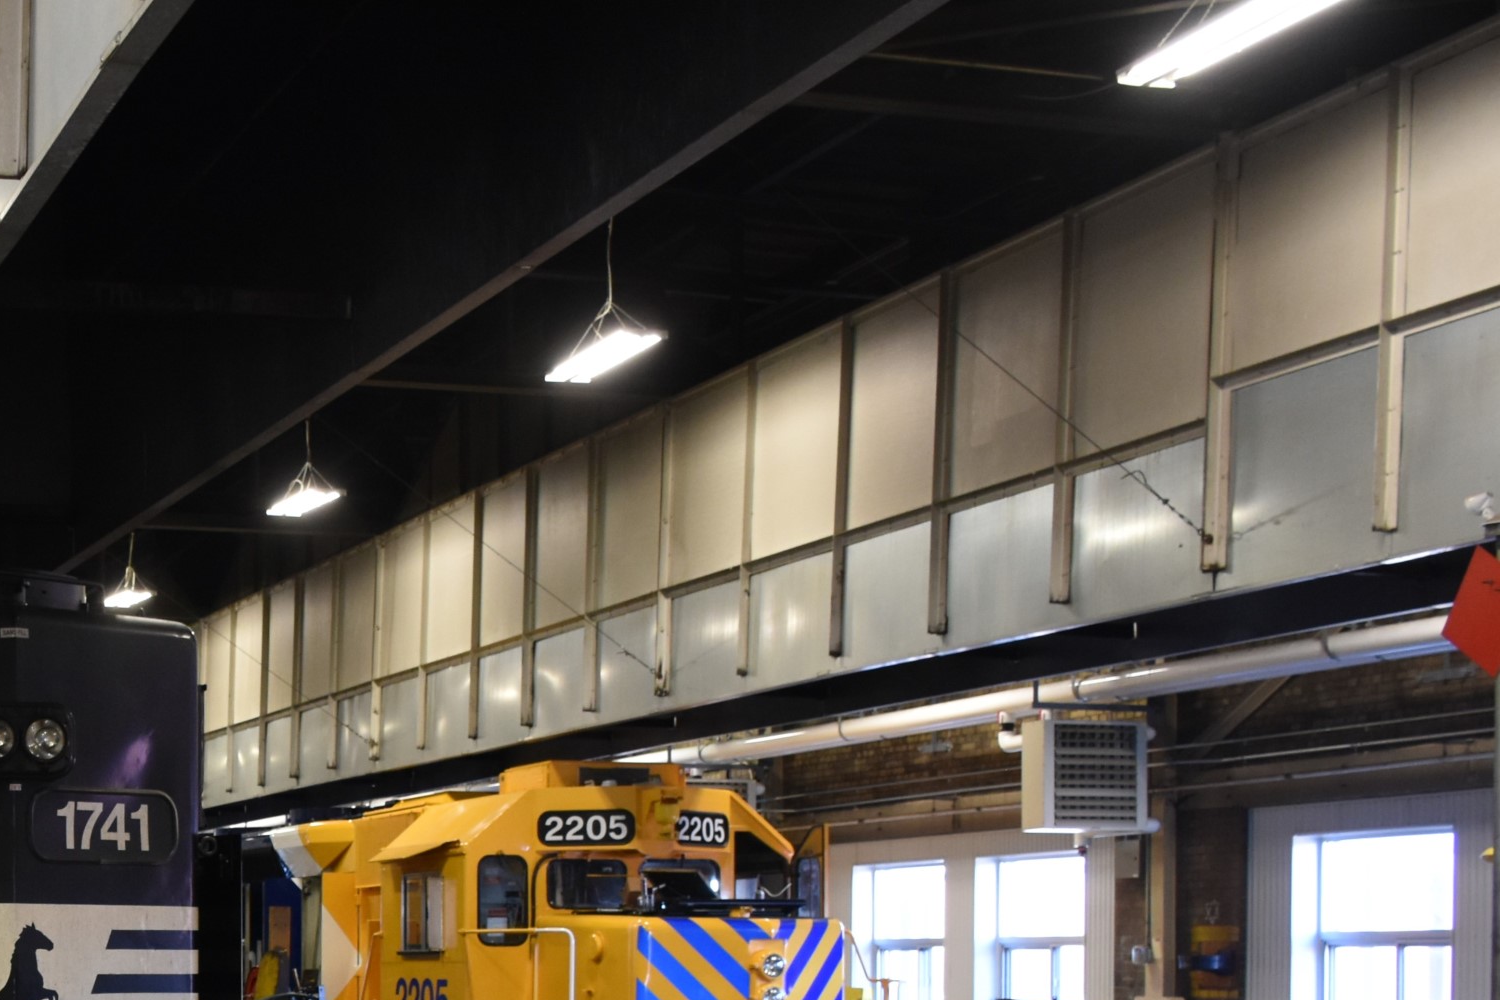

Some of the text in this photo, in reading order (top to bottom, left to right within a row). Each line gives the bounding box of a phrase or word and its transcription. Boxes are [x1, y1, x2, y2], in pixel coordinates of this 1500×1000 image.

[56, 801, 150, 852] 1741
[544, 814, 628, 841] 2205
[678, 816, 726, 843] 2205
